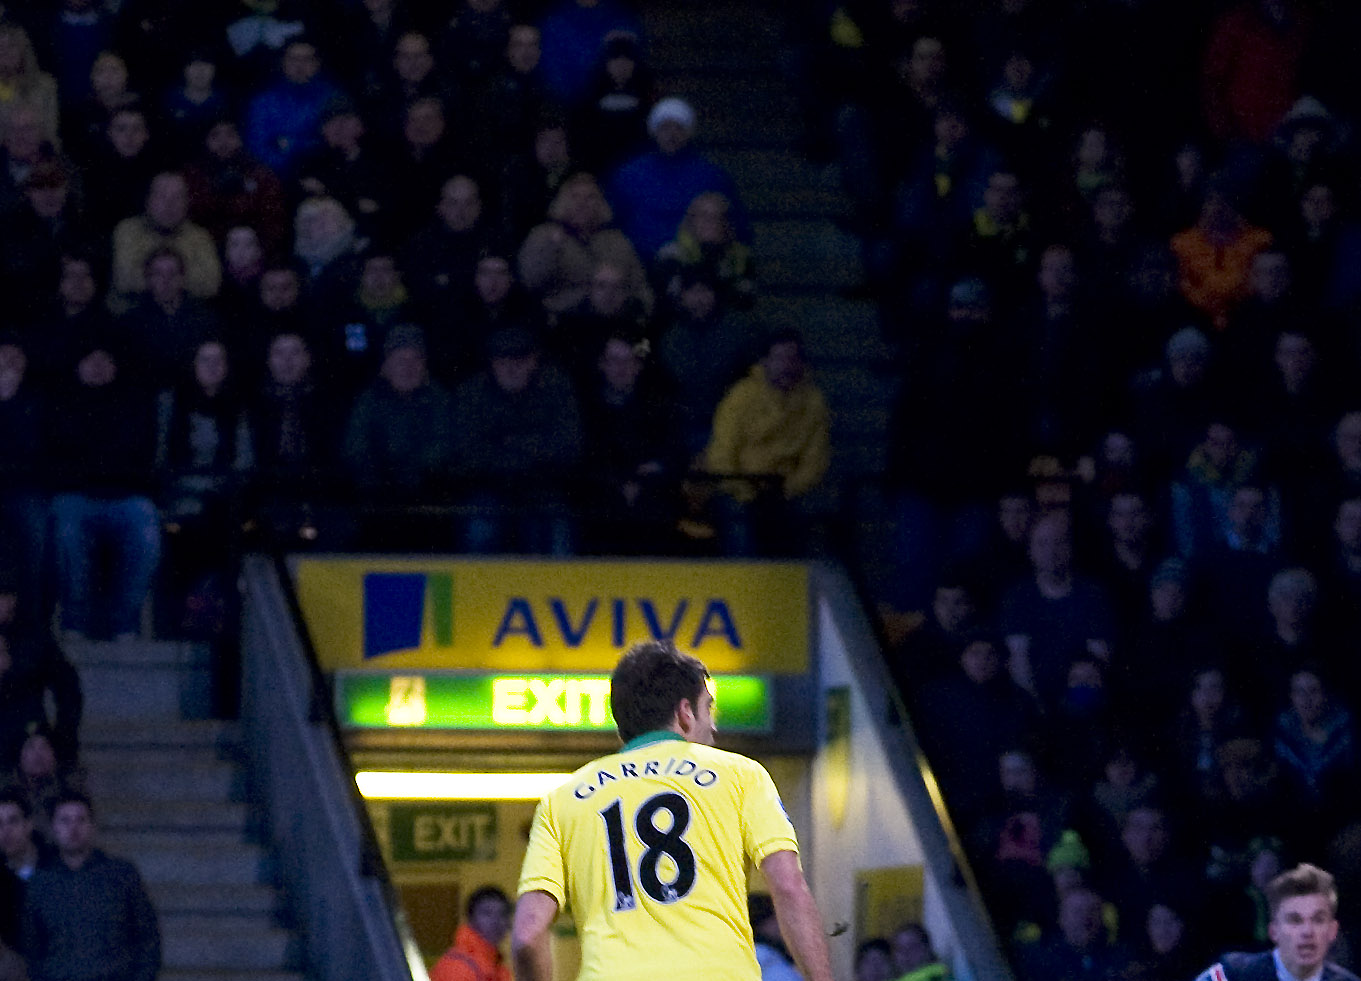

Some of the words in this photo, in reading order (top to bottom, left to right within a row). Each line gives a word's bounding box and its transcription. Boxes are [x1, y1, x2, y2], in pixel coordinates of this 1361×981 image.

[492, 597, 743, 648] AVIVA
[492, 677, 613, 726] EXIT
[574, 758, 718, 800] GARRIDO
[414, 815, 490, 849] EXIT
[597, 790, 697, 912] 18
